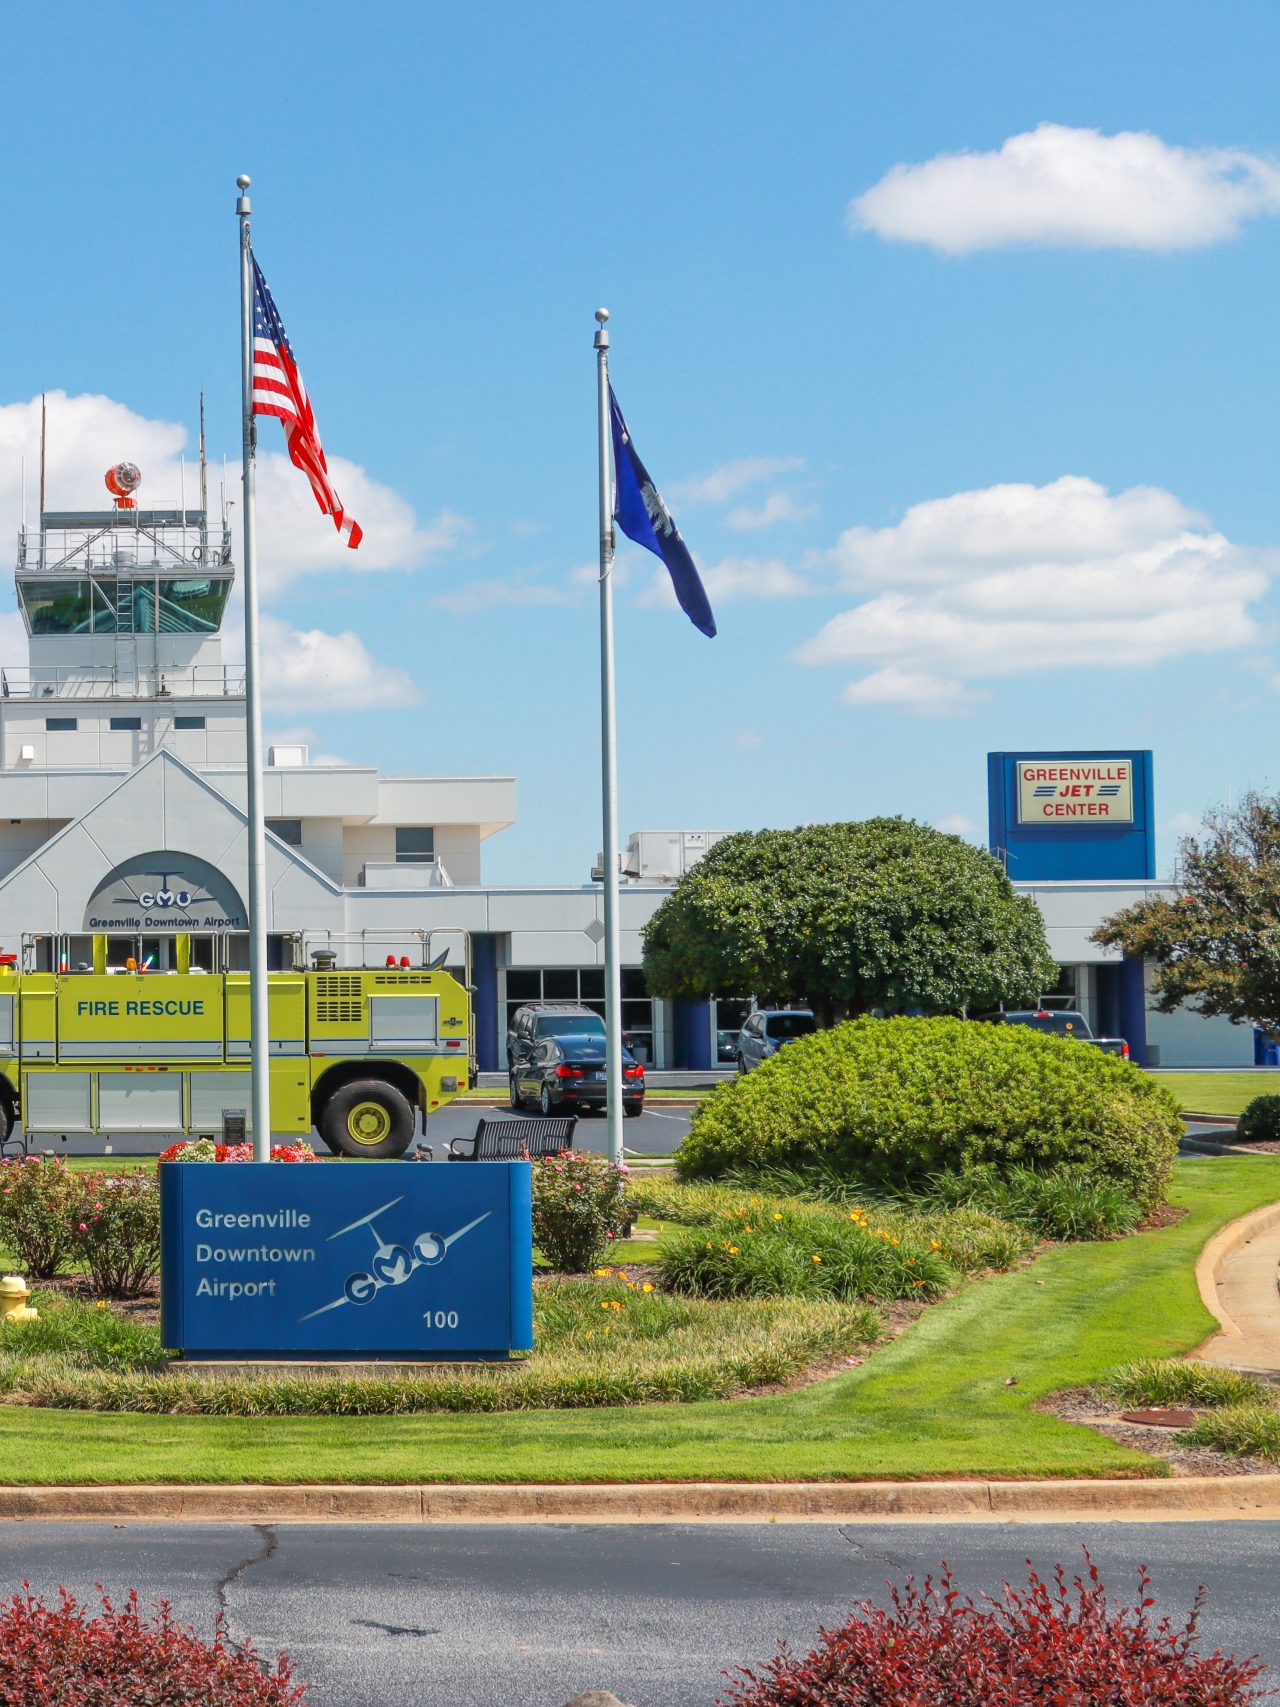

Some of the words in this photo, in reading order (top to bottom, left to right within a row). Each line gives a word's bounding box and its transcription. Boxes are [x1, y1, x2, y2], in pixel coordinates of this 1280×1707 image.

[1023, 768, 1127, 781] GREENVILLE
[1059, 785, 1094, 797] JET
[1043, 803, 1109, 816] CENTER
[139, 890, 192, 908] GMU
[89, 917, 141, 928] Greenville
[145, 917, 199, 927] Downtown
[204, 916, 240, 930] Airport
[77, 1001, 119, 1016] FIRE
[126, 1000, 205, 1016] RESCUE
[195, 1208, 311, 1229] Greenville
[196, 1244, 316, 1262] Downtown
[195, 1278, 277, 1301] Airport
[422, 1310, 459, 1329] 100
